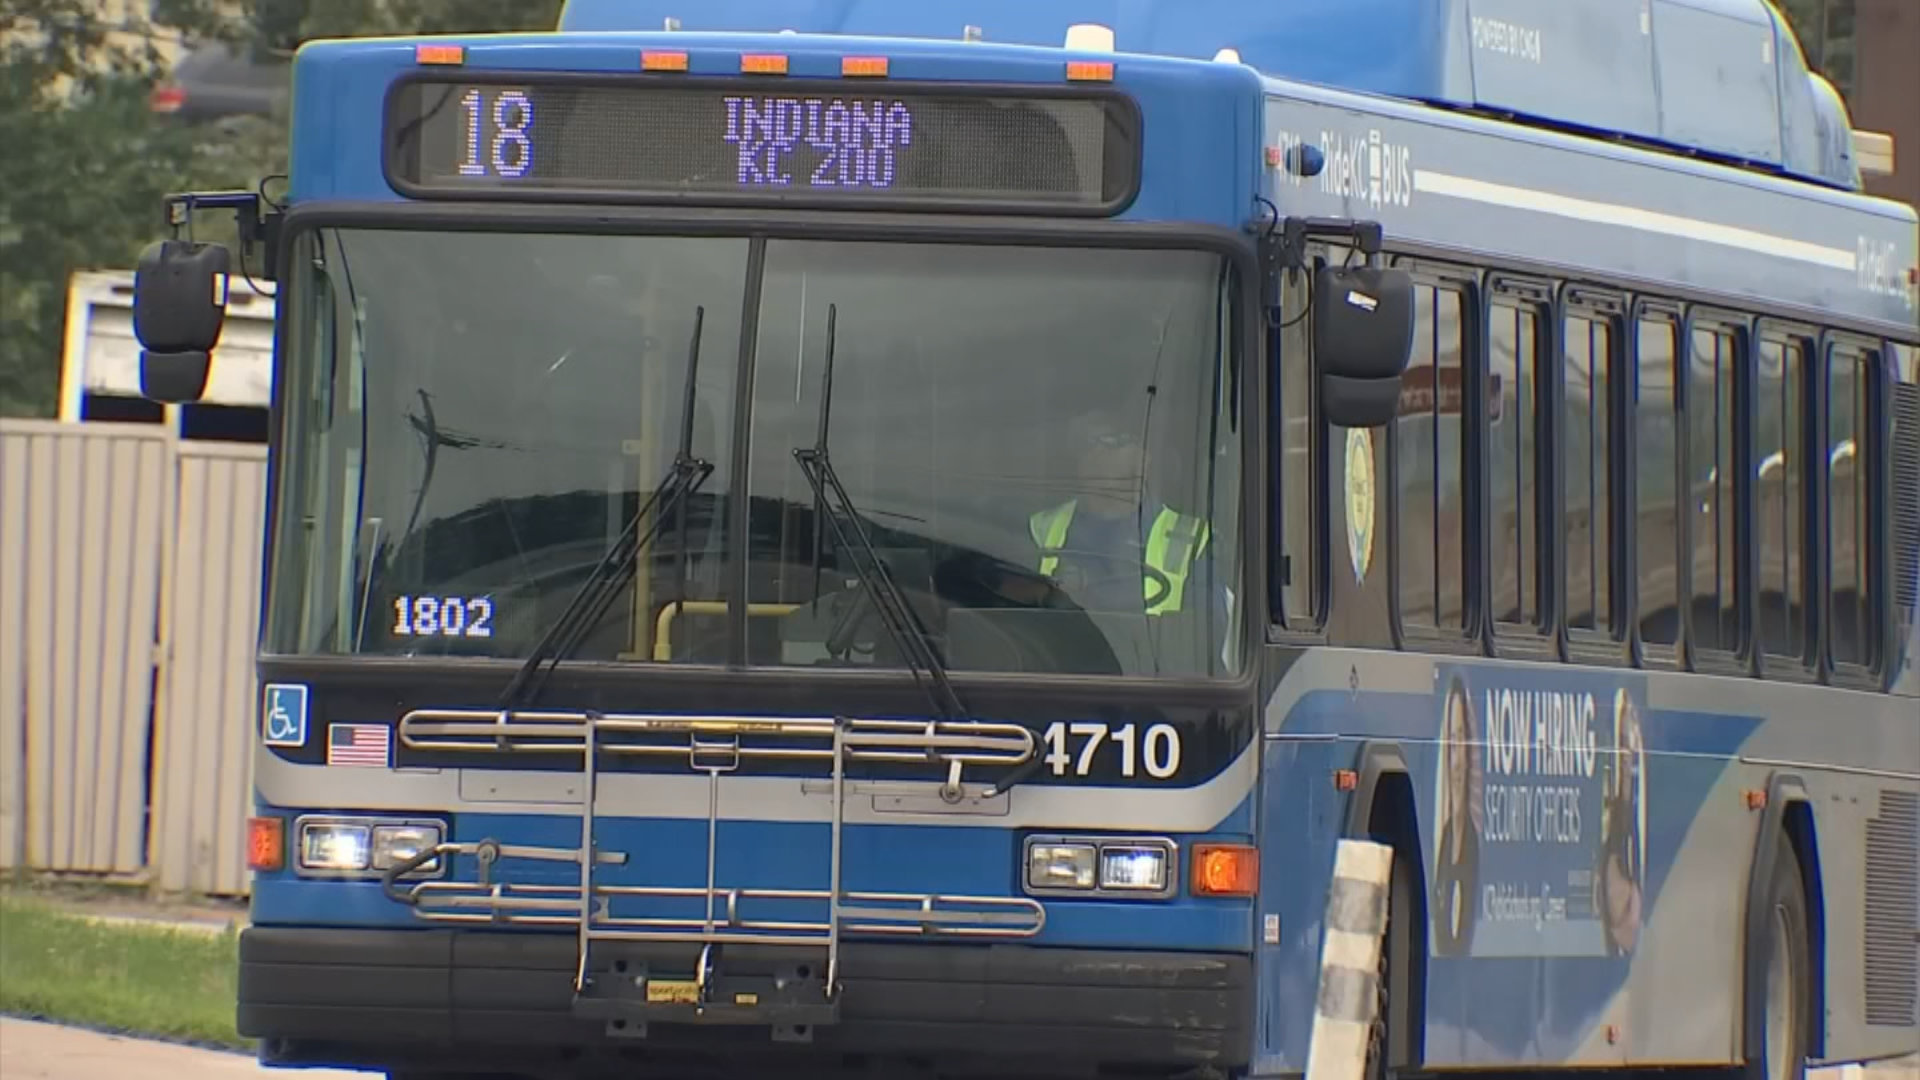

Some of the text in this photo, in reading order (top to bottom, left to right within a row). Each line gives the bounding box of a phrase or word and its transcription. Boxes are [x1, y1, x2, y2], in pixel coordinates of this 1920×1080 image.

[458, 89, 533, 177] 18
[722, 96, 912, 146] INDIANA
[737, 141, 792, 185] KC
[1320, 130, 1368, 200] RideKC
[1382, 143, 1411, 207] BUS
[393, 595, 492, 637] 1802
[1043, 721, 1181, 778] 4710
[1485, 687, 1597, 778] NOW HIRING
[1484, 784, 1581, 842] SECURITY OFFICERS
